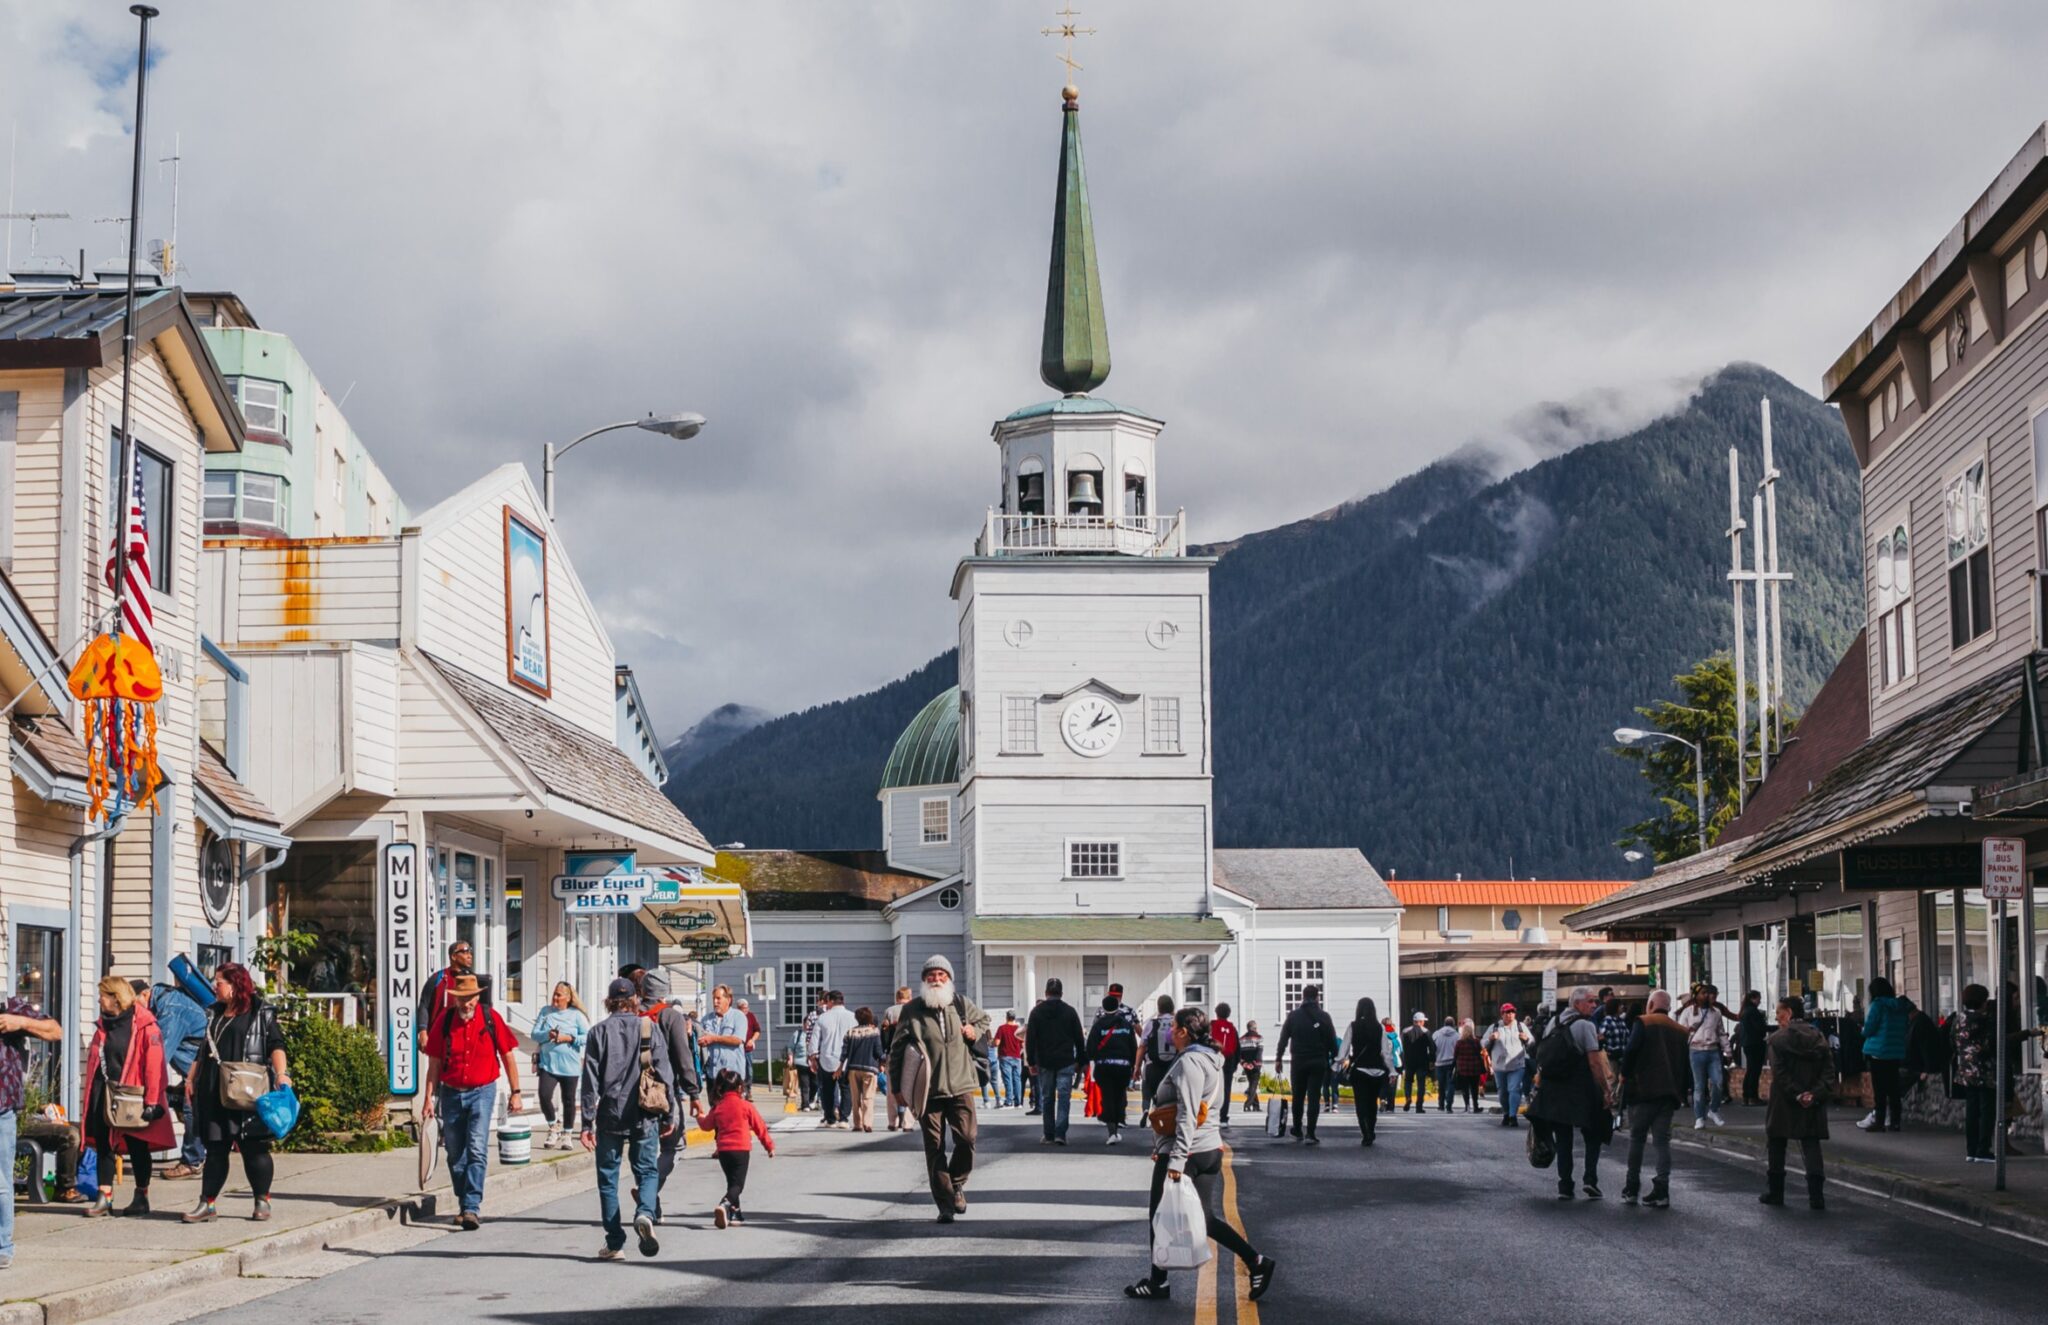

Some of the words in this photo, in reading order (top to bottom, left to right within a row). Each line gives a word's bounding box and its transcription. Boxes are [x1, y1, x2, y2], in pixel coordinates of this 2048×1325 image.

[523, 656, 542, 678] BEAR
[1995, 854, 2011, 862] BUS
[212, 861, 223, 887] 13
[1987, 864, 2019, 873] PARKING
[561, 879, 599, 890] Blue
[603, 877, 644, 891] Eyed
[1994, 875, 2012, 883] ONLY
[577, 894, 629, 907] BEAR
[391, 856, 411, 998] MUSEUM
[679, 917, 694, 926] GIFT
[210, 929, 224, 945] 205
[396, 1007, 410, 1085] QUALITY
